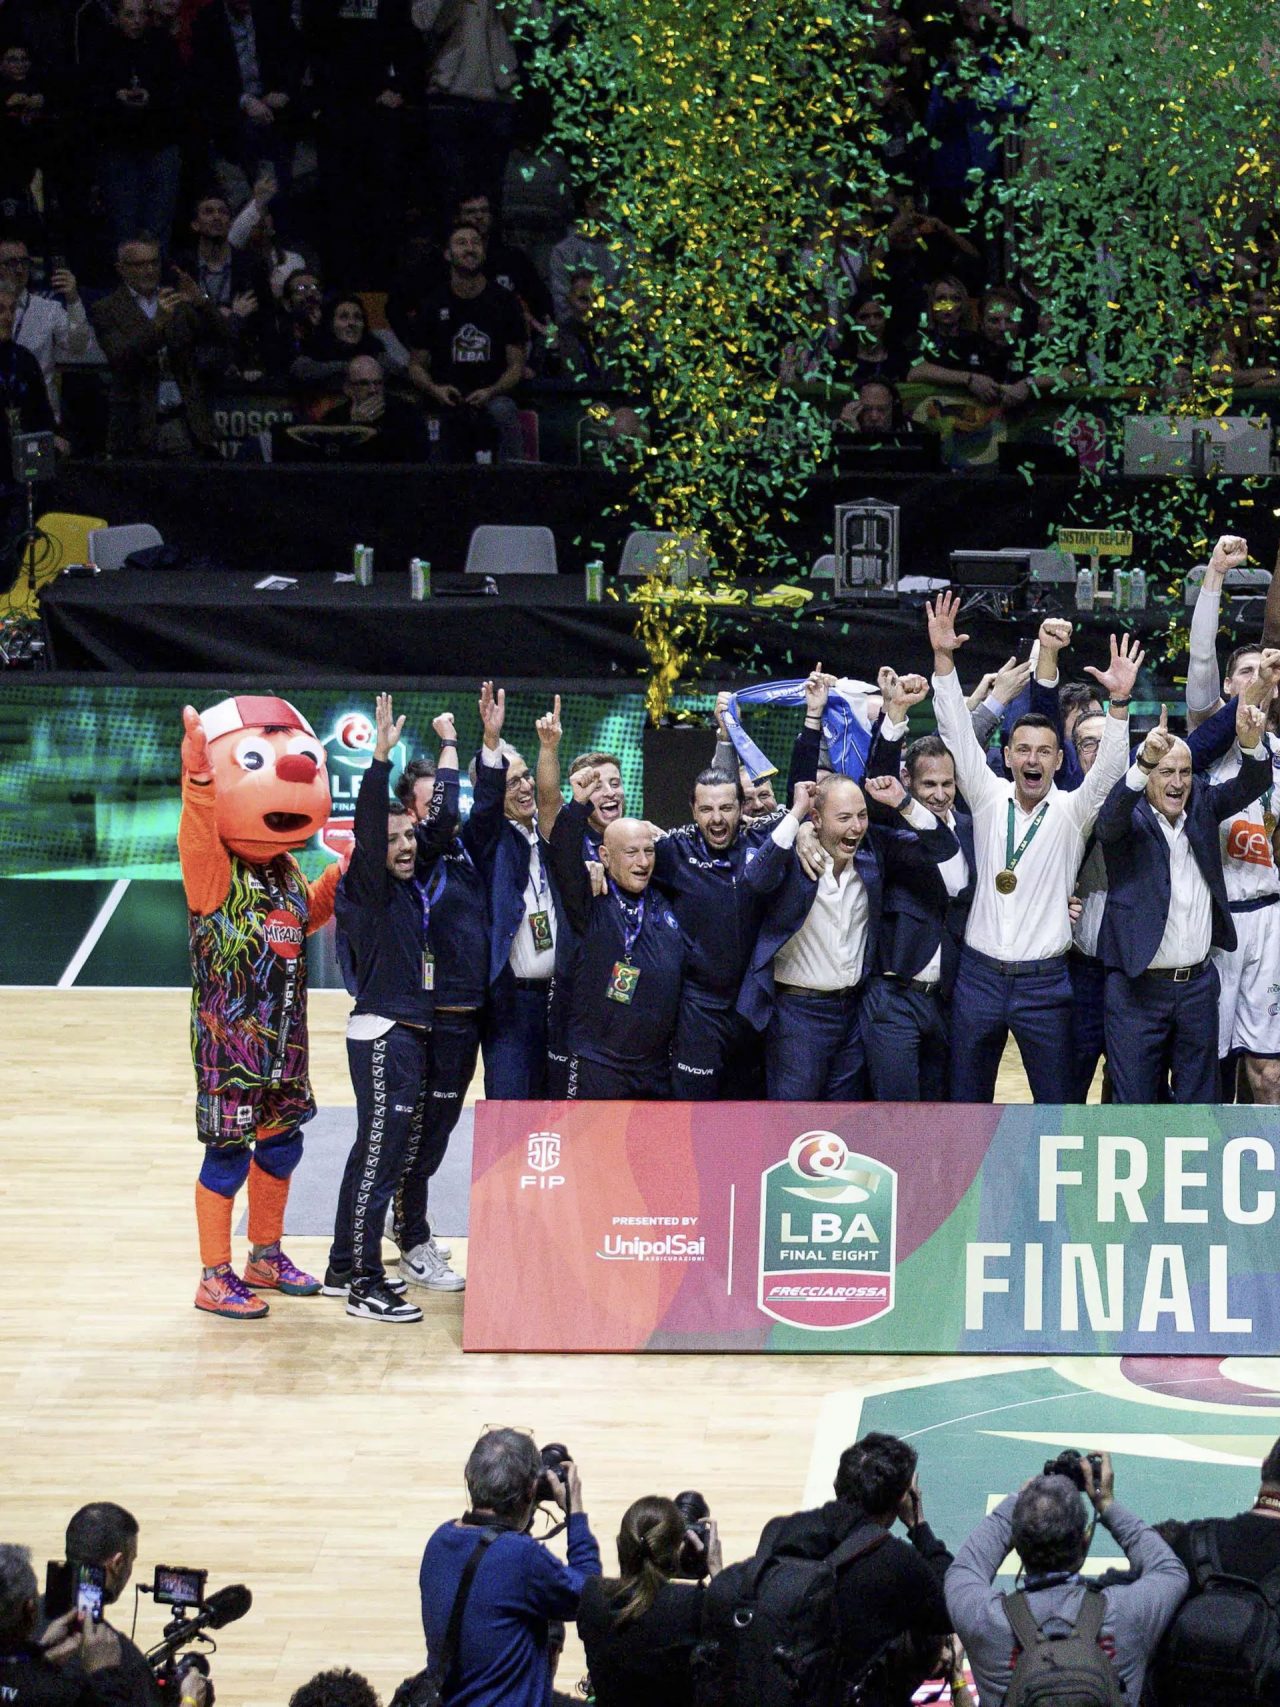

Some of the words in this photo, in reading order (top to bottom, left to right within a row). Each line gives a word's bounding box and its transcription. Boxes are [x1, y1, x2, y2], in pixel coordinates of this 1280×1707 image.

[677, 1062, 714, 1075] GIVOVA
[520, 1175, 565, 1189] FIP
[612, 1216, 679, 1226] PRESENTED
[681, 1216, 698, 1226] BY
[780, 1213, 879, 1244] LBA
[604, 1234, 705, 1261] UnipolSai
[780, 1250, 827, 1261] FINAL
[832, 1250, 879, 1262] EIGHT
[769, 1286, 887, 1298] FRECCIAROSSA
[964, 1243, 1252, 1333] FINAL
